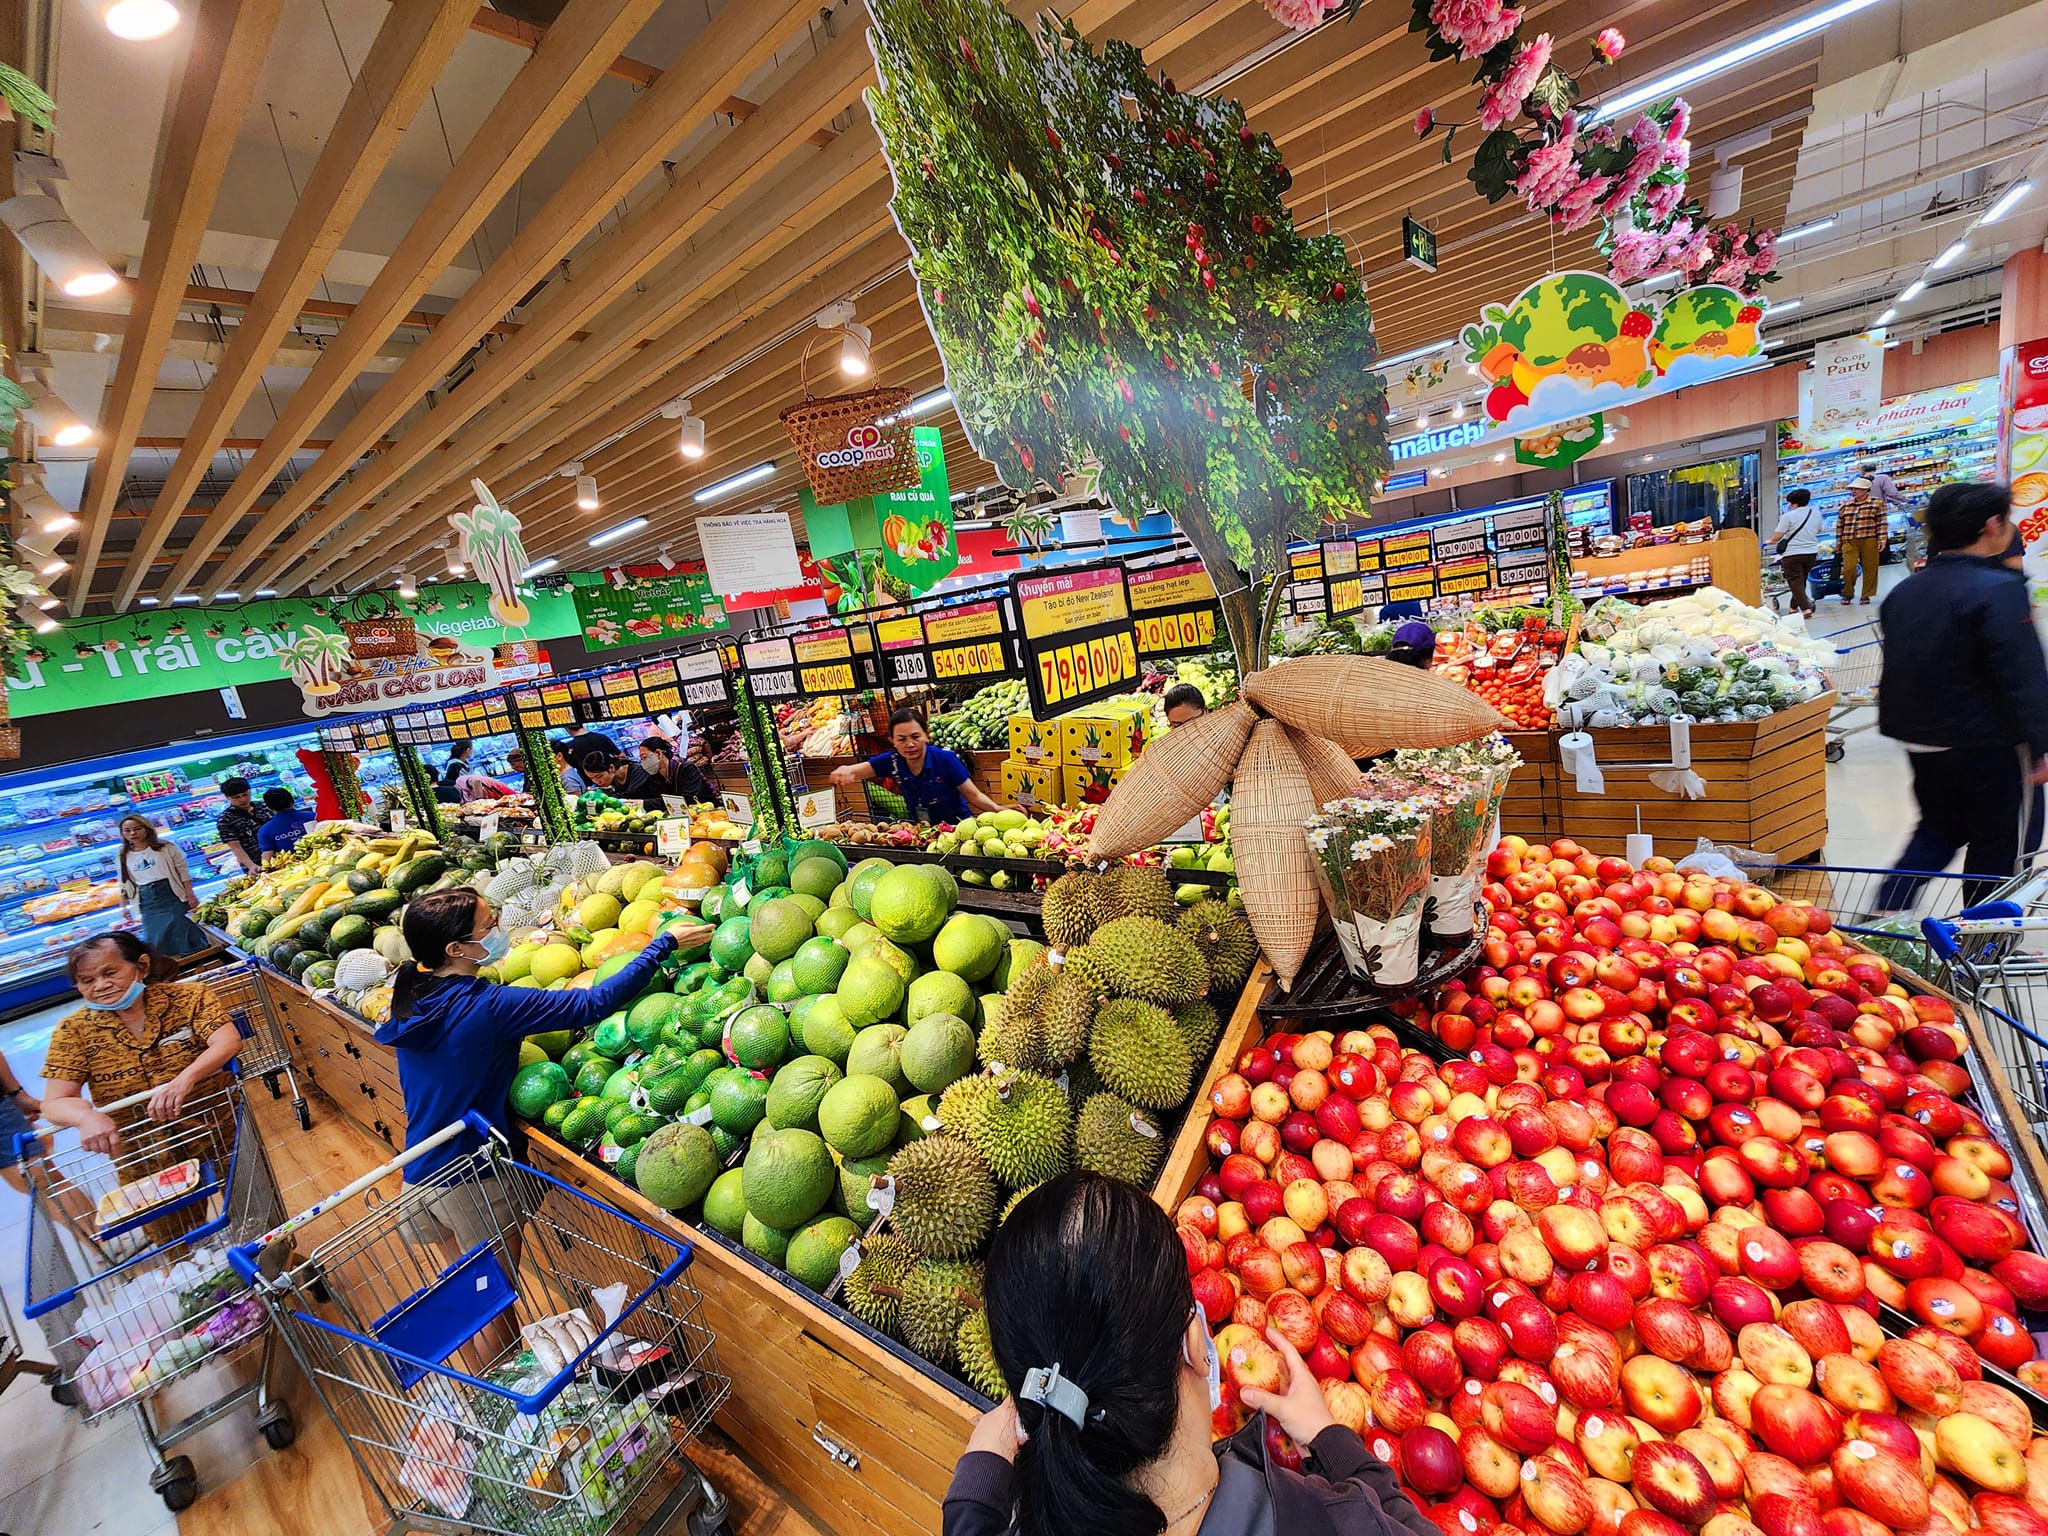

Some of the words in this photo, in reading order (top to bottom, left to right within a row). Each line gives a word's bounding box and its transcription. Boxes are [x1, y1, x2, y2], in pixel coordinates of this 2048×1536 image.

[1827, 361, 1870, 376] Party
[890, 491, 907, 501] RAU
[1018, 577, 1055, 597] Khuyến
[1056, 576, 1073, 591] mãi
[1138, 571, 1154, 582] mãi
[1076, 594, 1090, 604] New
[1090, 588, 1114, 601] Zealand
[91, 632, 201, 678] Trái
[936, 649, 988, 673] 54.900
[803, 668, 843, 689] 49.900
[1042, 646, 1119, 695] 79.900
[383, 672, 432, 698] CÁC
[435, 667, 487, 690] LOẠI
[752, 675, 787, 691] 37.200
